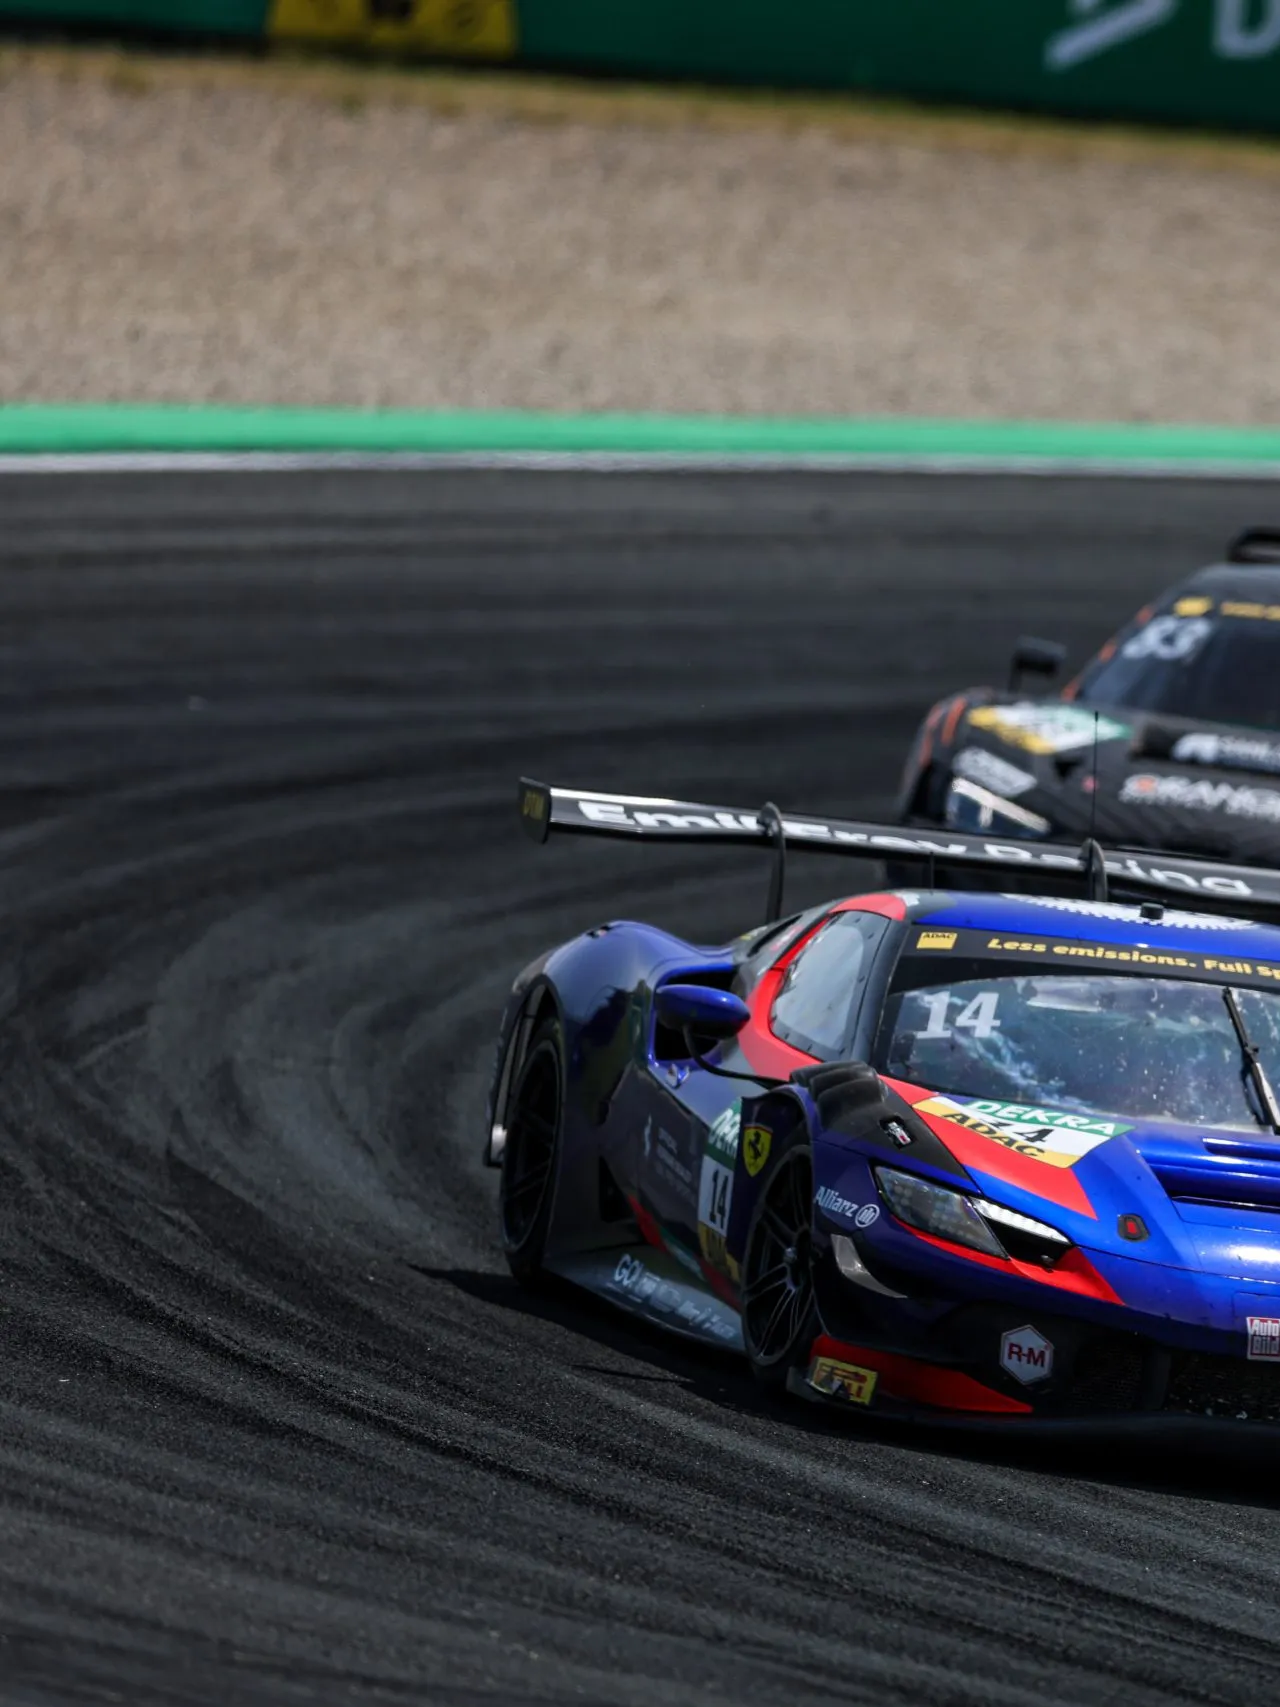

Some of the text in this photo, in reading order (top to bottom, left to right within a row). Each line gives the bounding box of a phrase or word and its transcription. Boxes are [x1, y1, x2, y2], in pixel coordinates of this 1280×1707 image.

[987, 938, 1047, 953] Less
[1052, 945, 1197, 968] emissions.
[1203, 959, 1252, 975] Full
[915, 991, 1001, 1039] 14
[942, 1112, 1046, 1158] ADAC
[964, 1100, 1117, 1137] DEKRA
[709, 1168, 730, 1220] 14
[815, 1185, 860, 1218] Allianz
[1250, 1319, 1280, 1337] Auto
[1007, 1342, 1045, 1369] R-M
